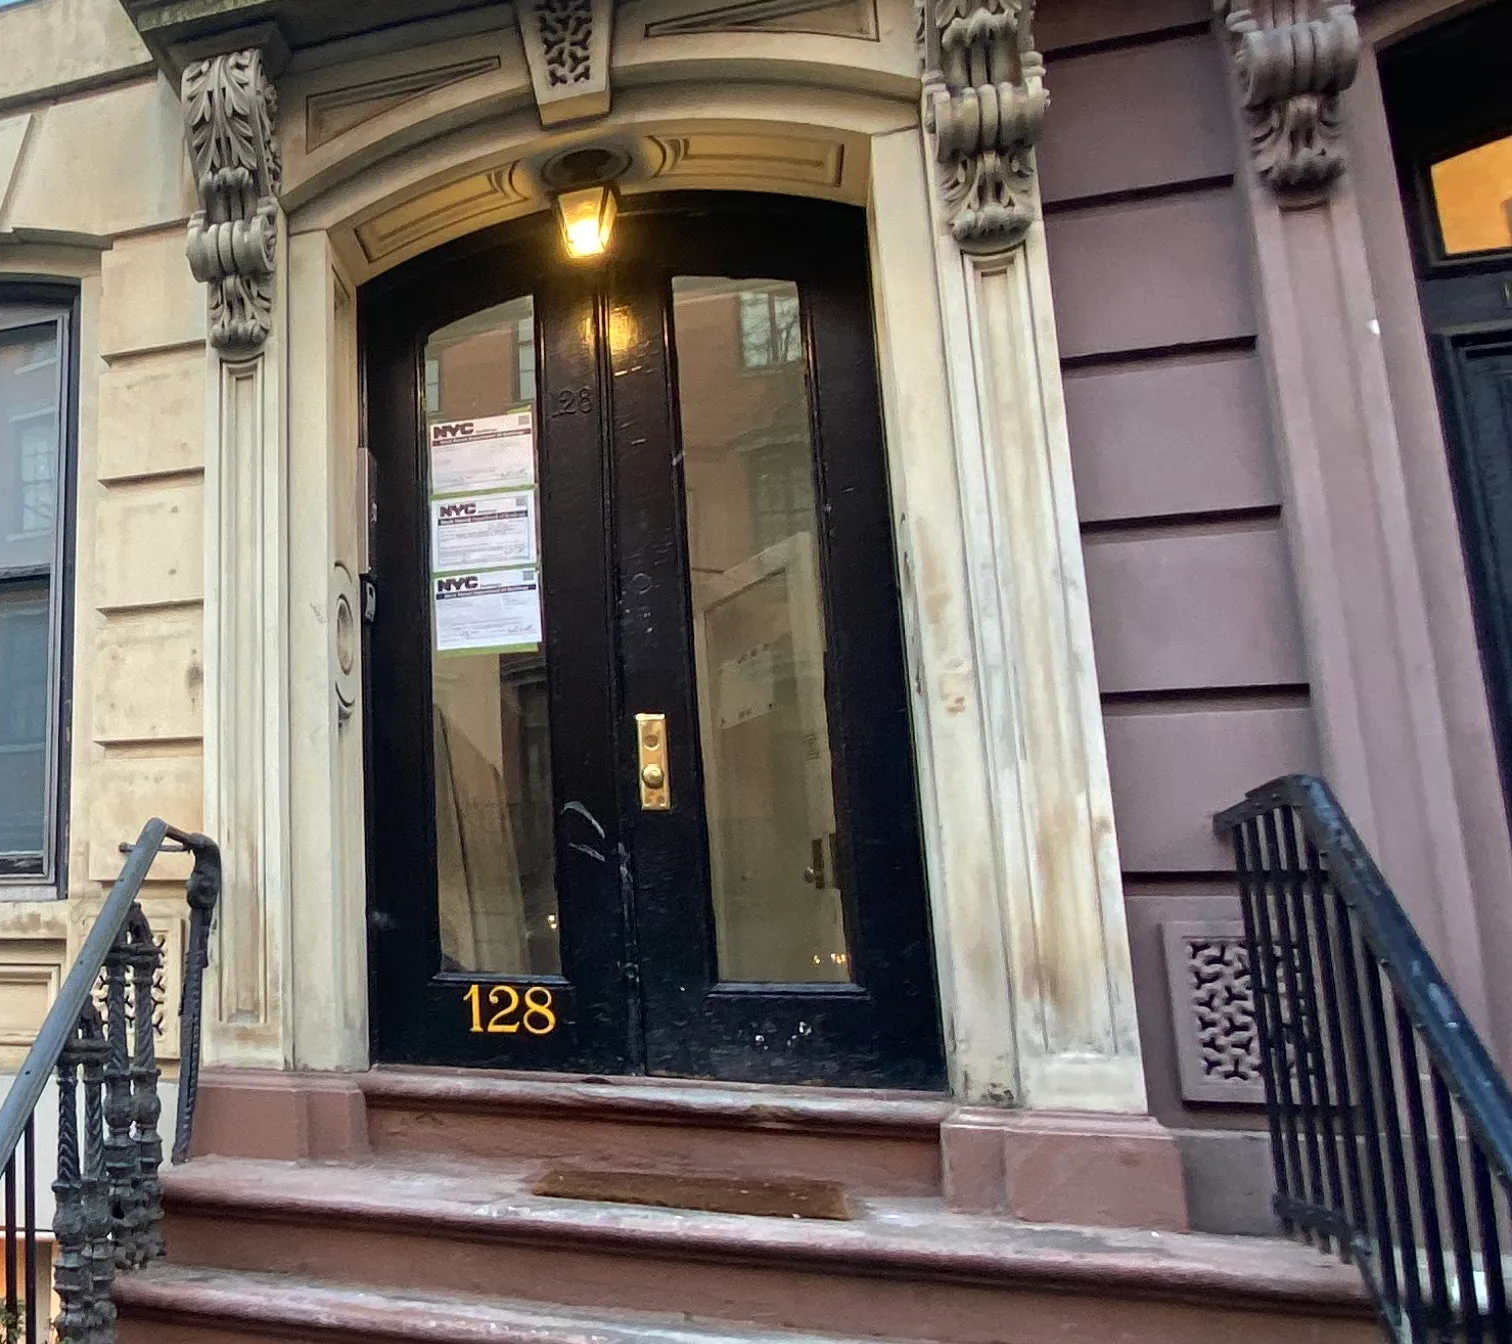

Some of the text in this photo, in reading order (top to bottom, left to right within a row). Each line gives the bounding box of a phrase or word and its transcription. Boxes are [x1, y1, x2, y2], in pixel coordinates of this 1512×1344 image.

[433, 422, 474, 439] NYC
[440, 503, 476, 517] NYC
[438, 576, 478, 592] NYC
[463, 984, 556, 1034] 128
